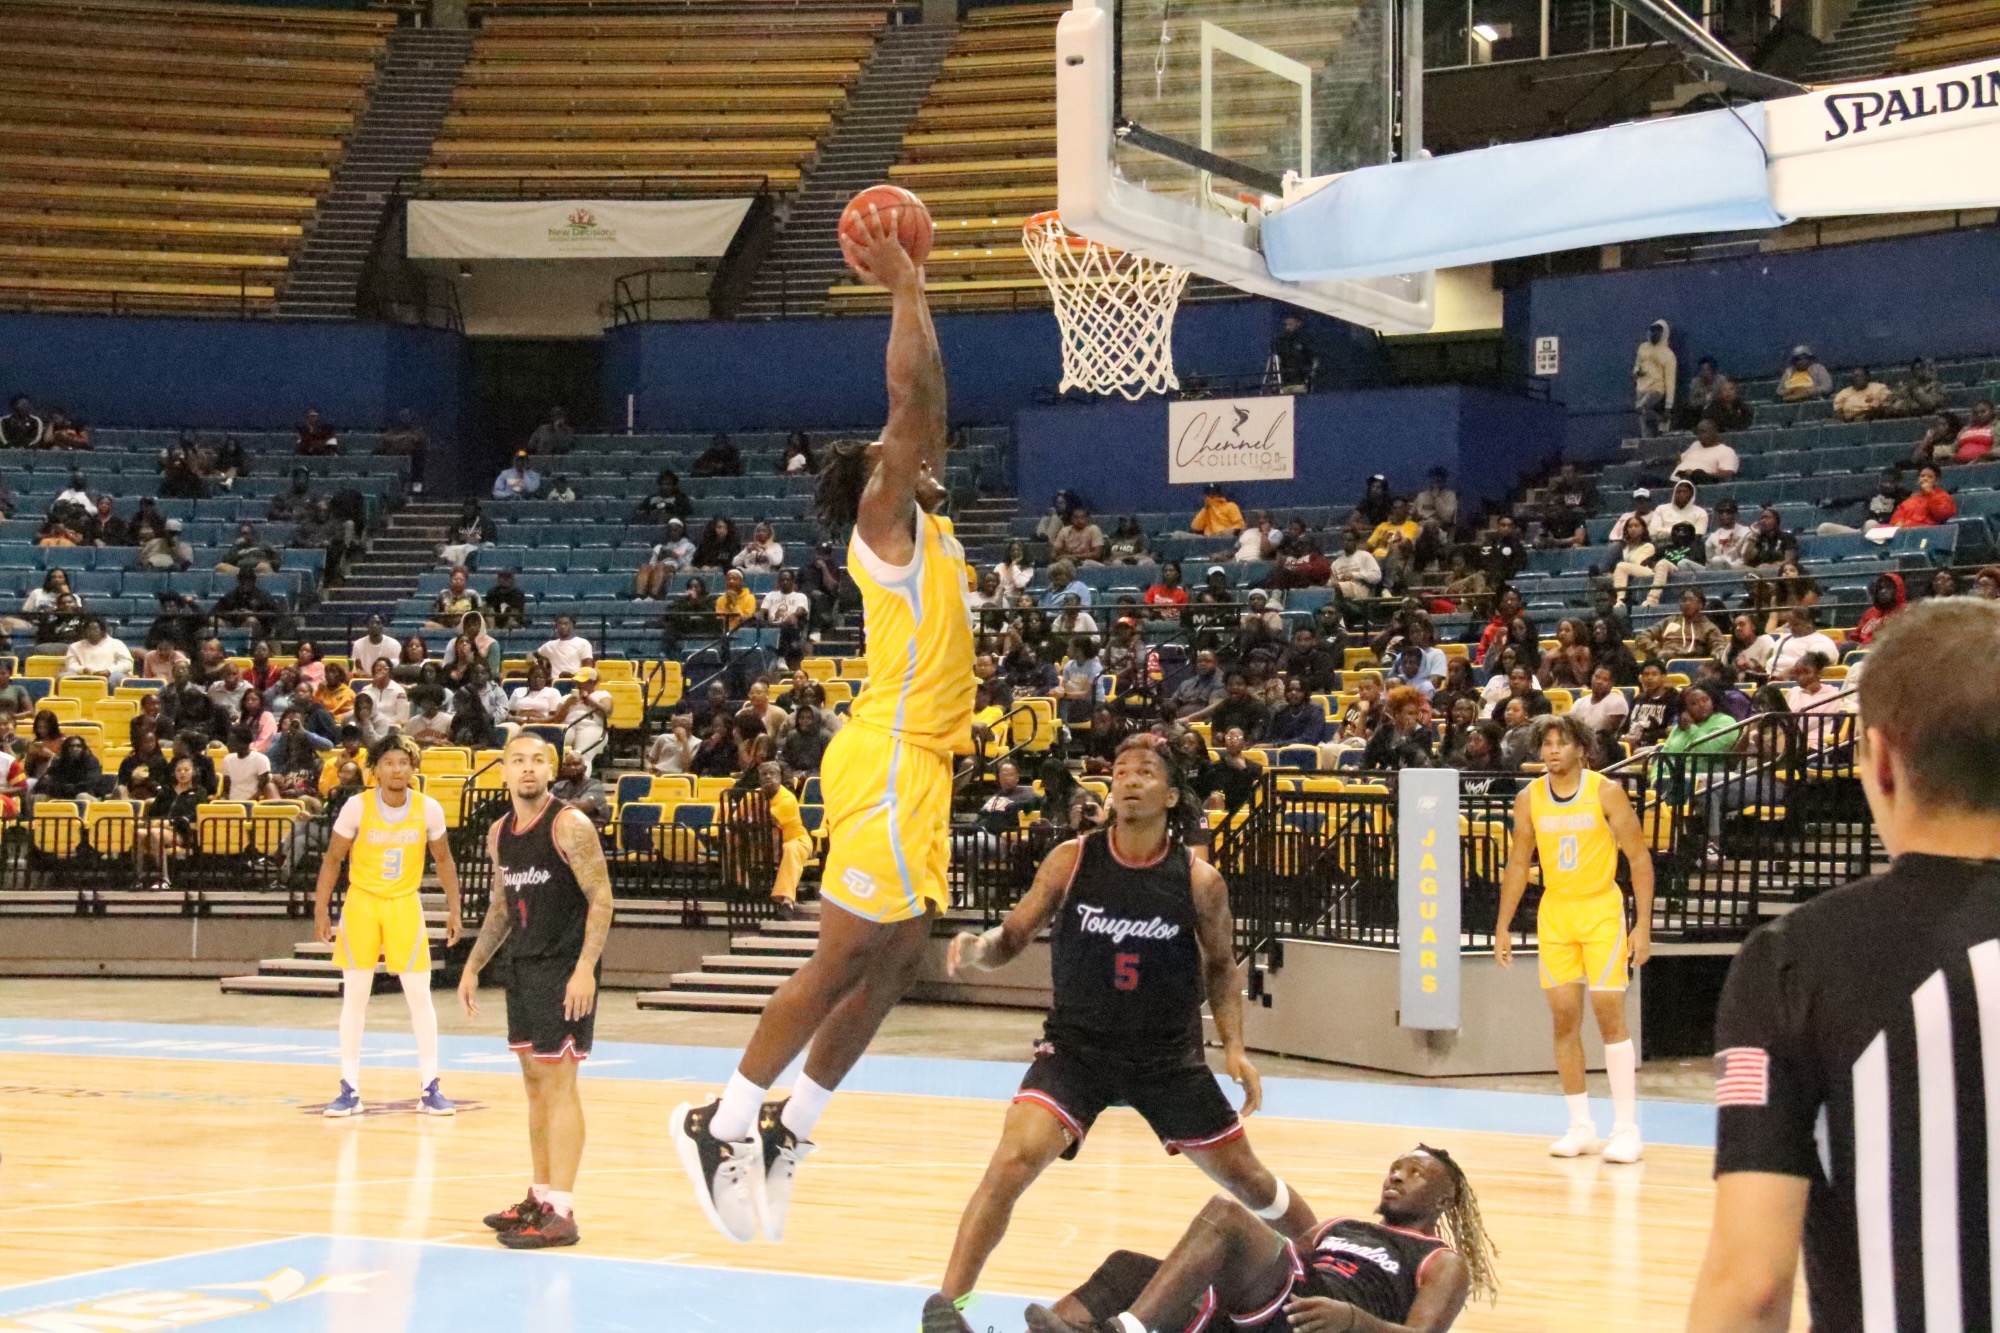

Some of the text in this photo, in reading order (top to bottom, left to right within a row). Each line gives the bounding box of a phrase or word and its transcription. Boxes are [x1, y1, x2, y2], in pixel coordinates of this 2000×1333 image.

[549, 228, 616, 236] New Decisions
[382, 848, 403, 879] 3
[518, 899, 527, 928] 1
[1077, 904, 1180, 944] Tougaloo
[1419, 829, 1438, 992] JAGUARS
[1115, 953, 1140, 990] 5
